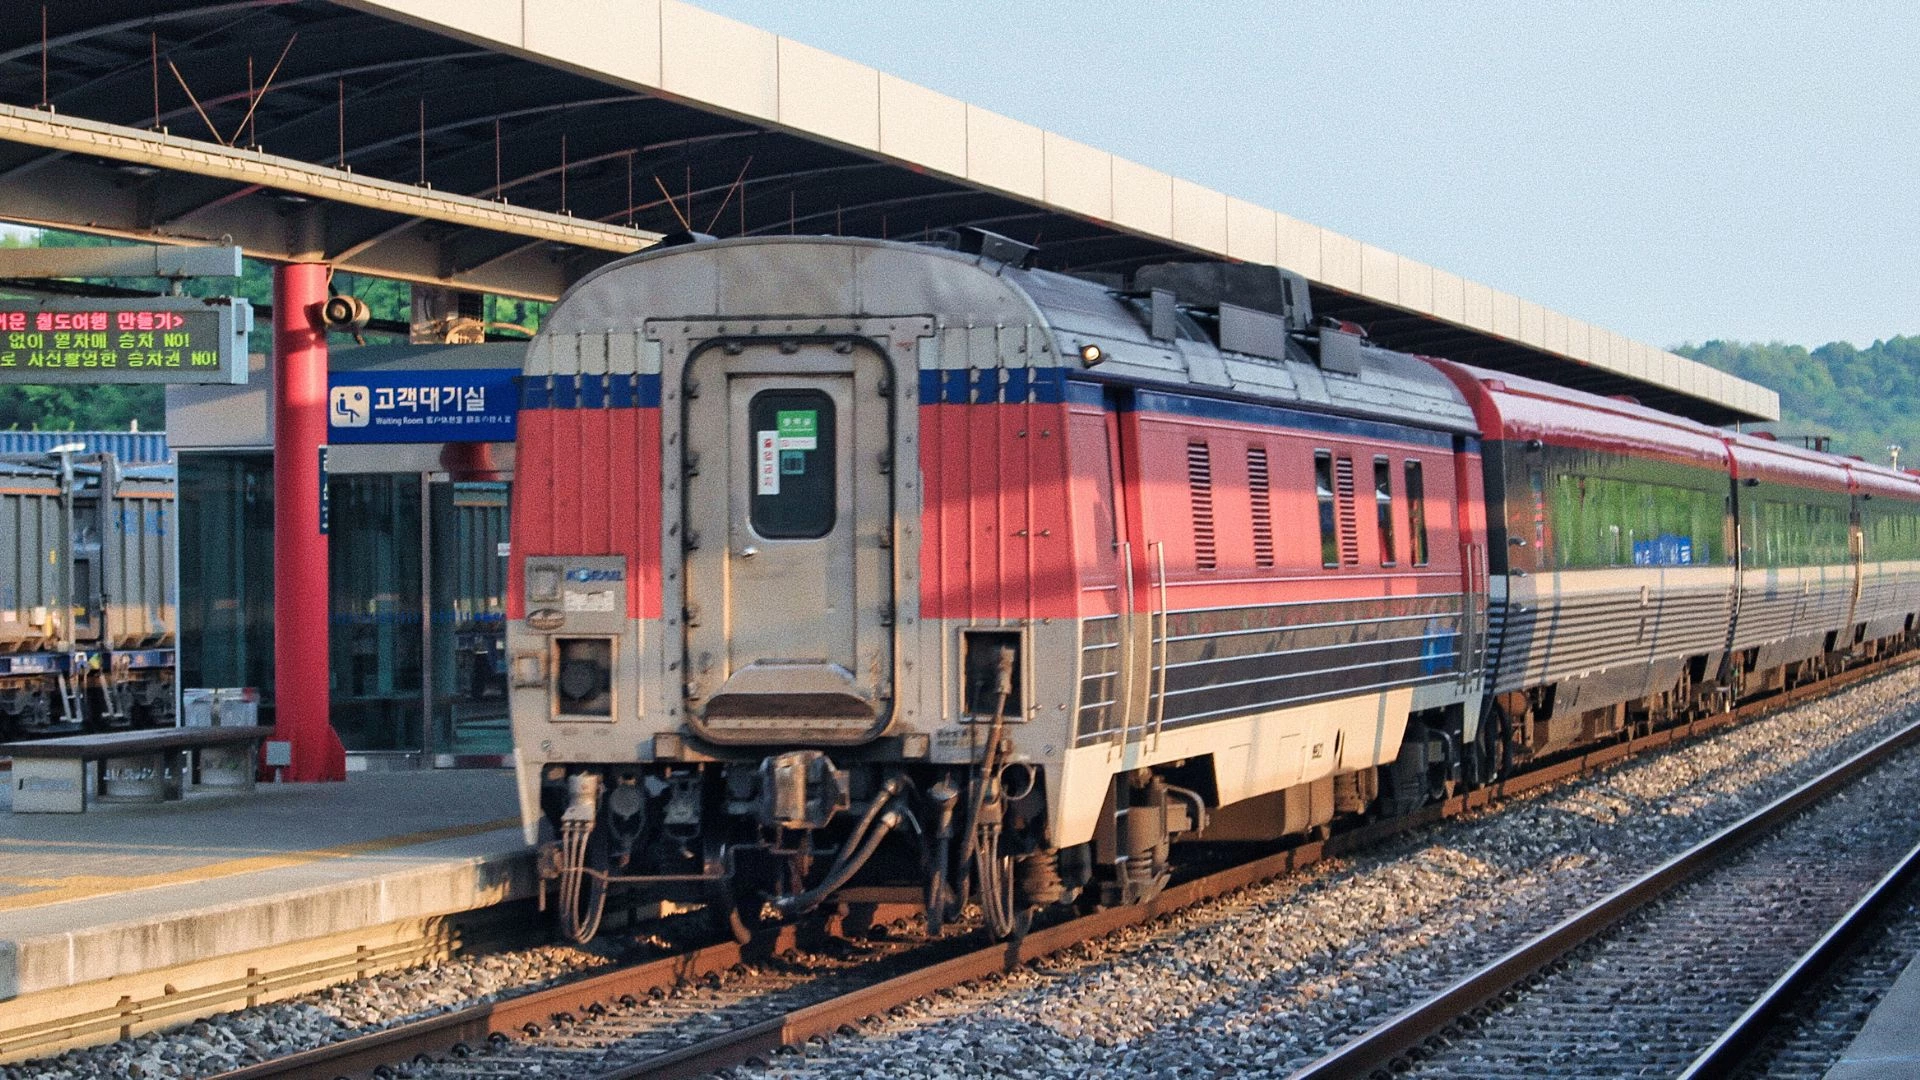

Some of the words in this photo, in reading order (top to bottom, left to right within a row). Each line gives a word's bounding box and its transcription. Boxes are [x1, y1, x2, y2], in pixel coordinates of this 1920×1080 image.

[36, 312, 108, 331] 철도여행
[9, 332, 43, 349] 없이
[54, 332, 107, 349] 열차에
[164, 333, 190, 348] NO!
[191, 351, 217, 366] NO!
[374, 386, 485, 412] 고객대기실
[376, 417, 402, 427] Waiting
[403, 416, 424, 425] Room
